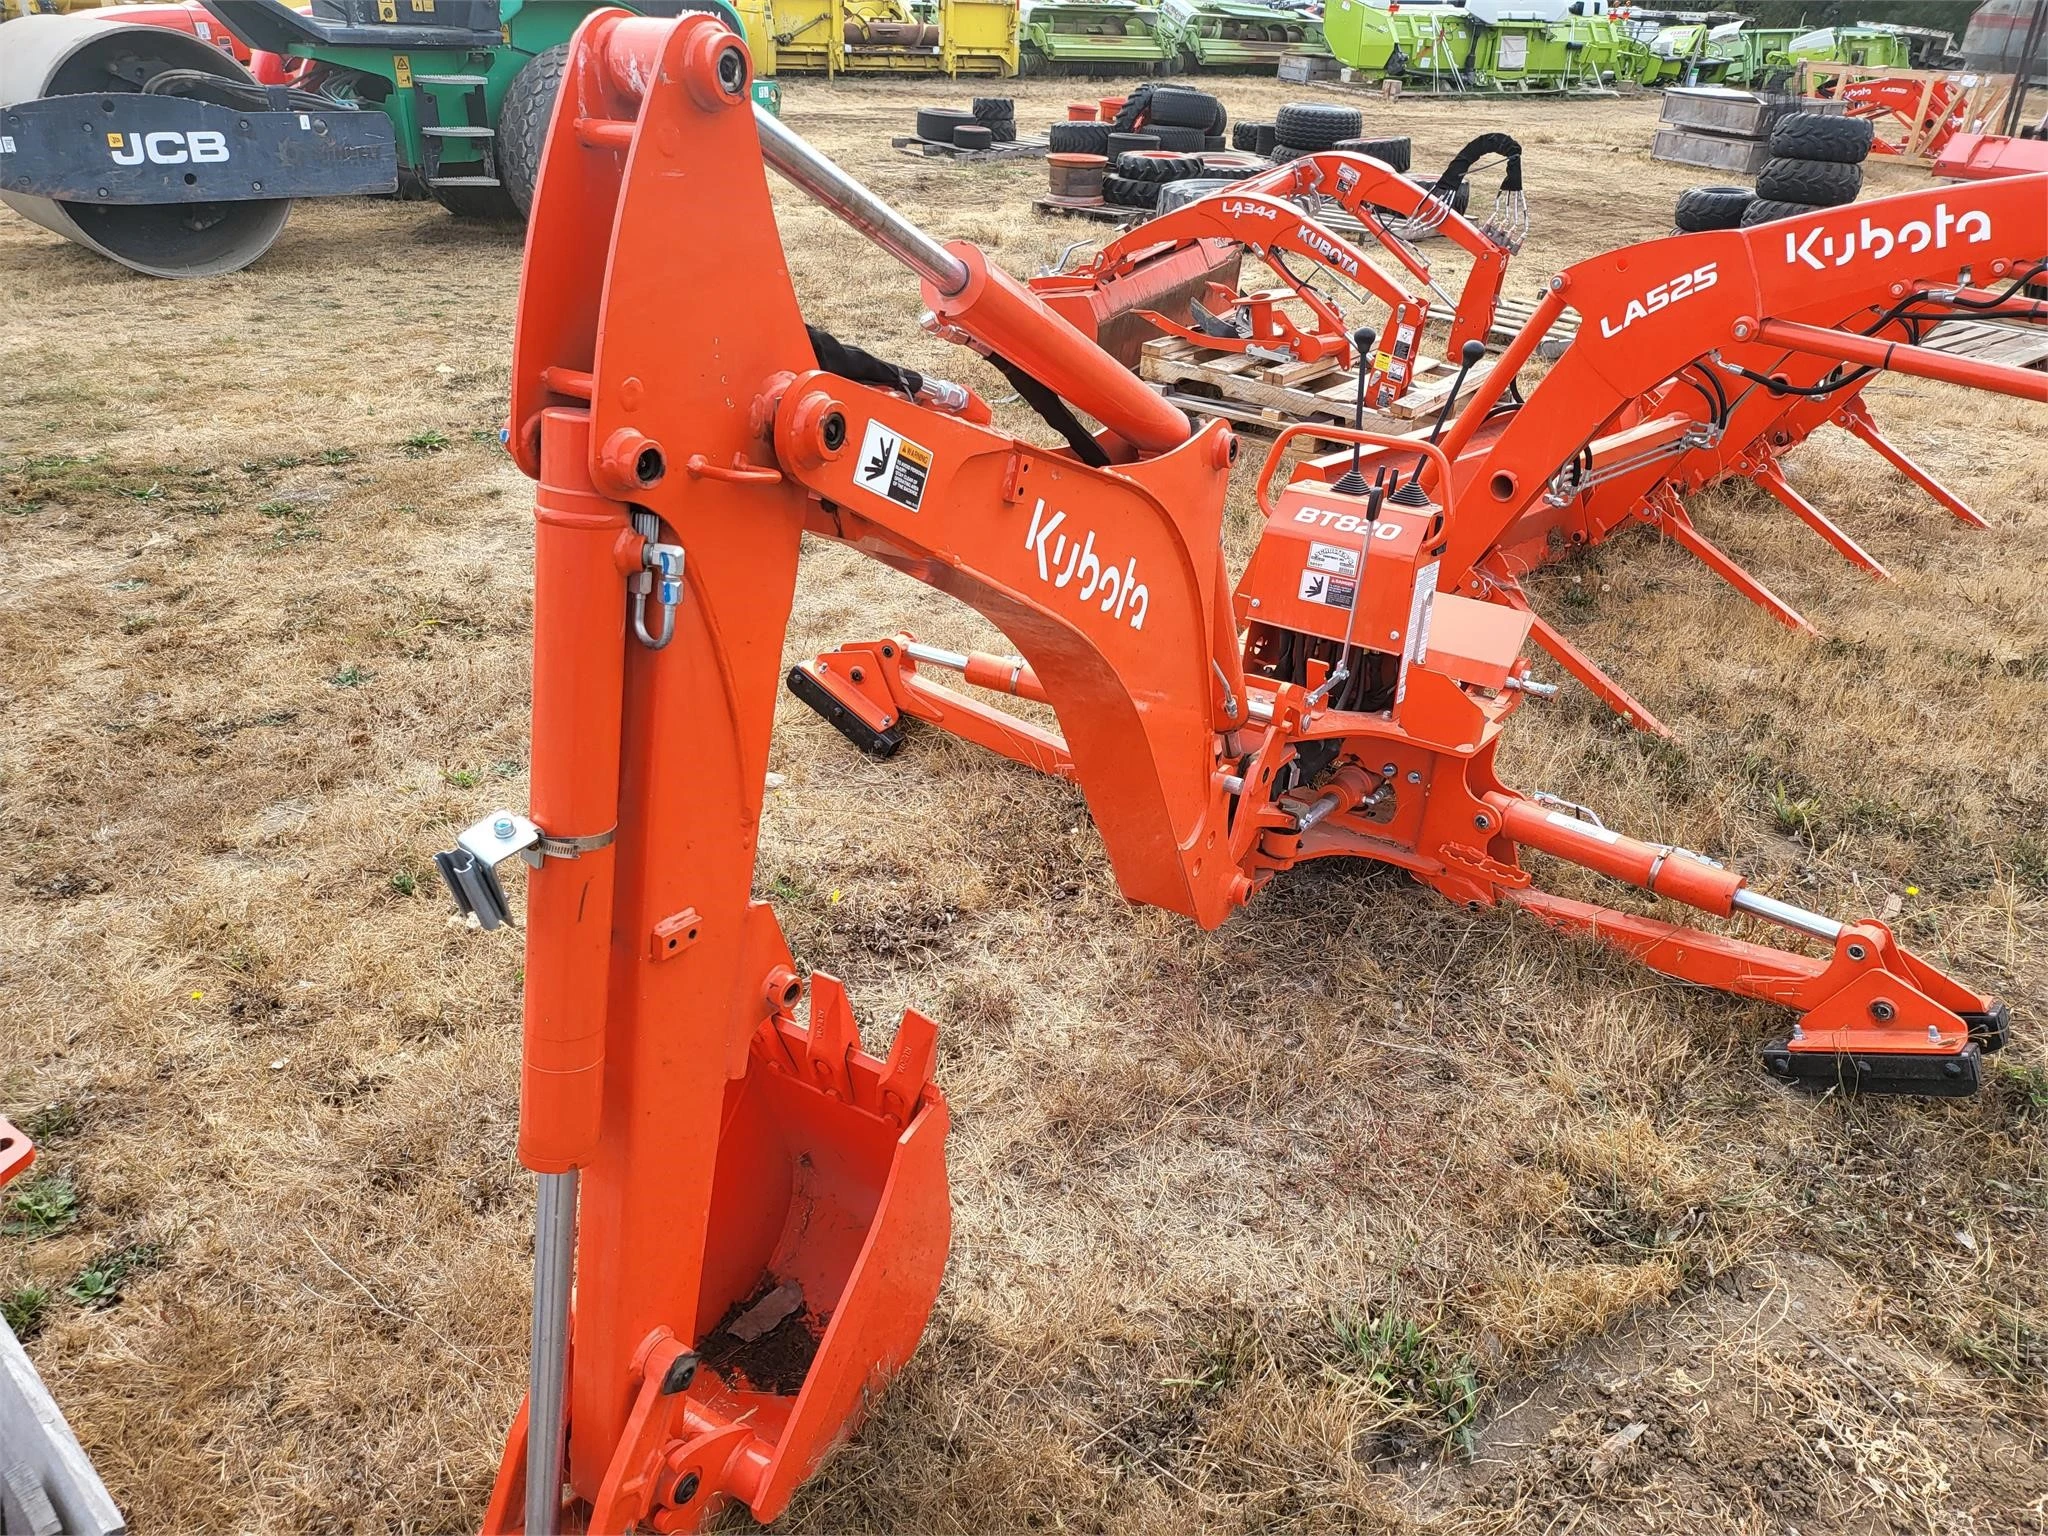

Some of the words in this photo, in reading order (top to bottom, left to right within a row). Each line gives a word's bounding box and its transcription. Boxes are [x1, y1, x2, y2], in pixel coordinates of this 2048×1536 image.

[1844, 87, 1872, 98] ubota
[110, 132, 230, 165] JCB
[1222, 201, 1277, 220] LA344
[1297, 225, 1358, 277] KUBOTA
[1786, 203, 1992, 270] Kubota
[1600, 262, 1718, 339] LA525
[907, 449, 929, 464] WARNING
[1294, 507, 1402, 540] BT820
[1025, 498, 1149, 630] Kubota
